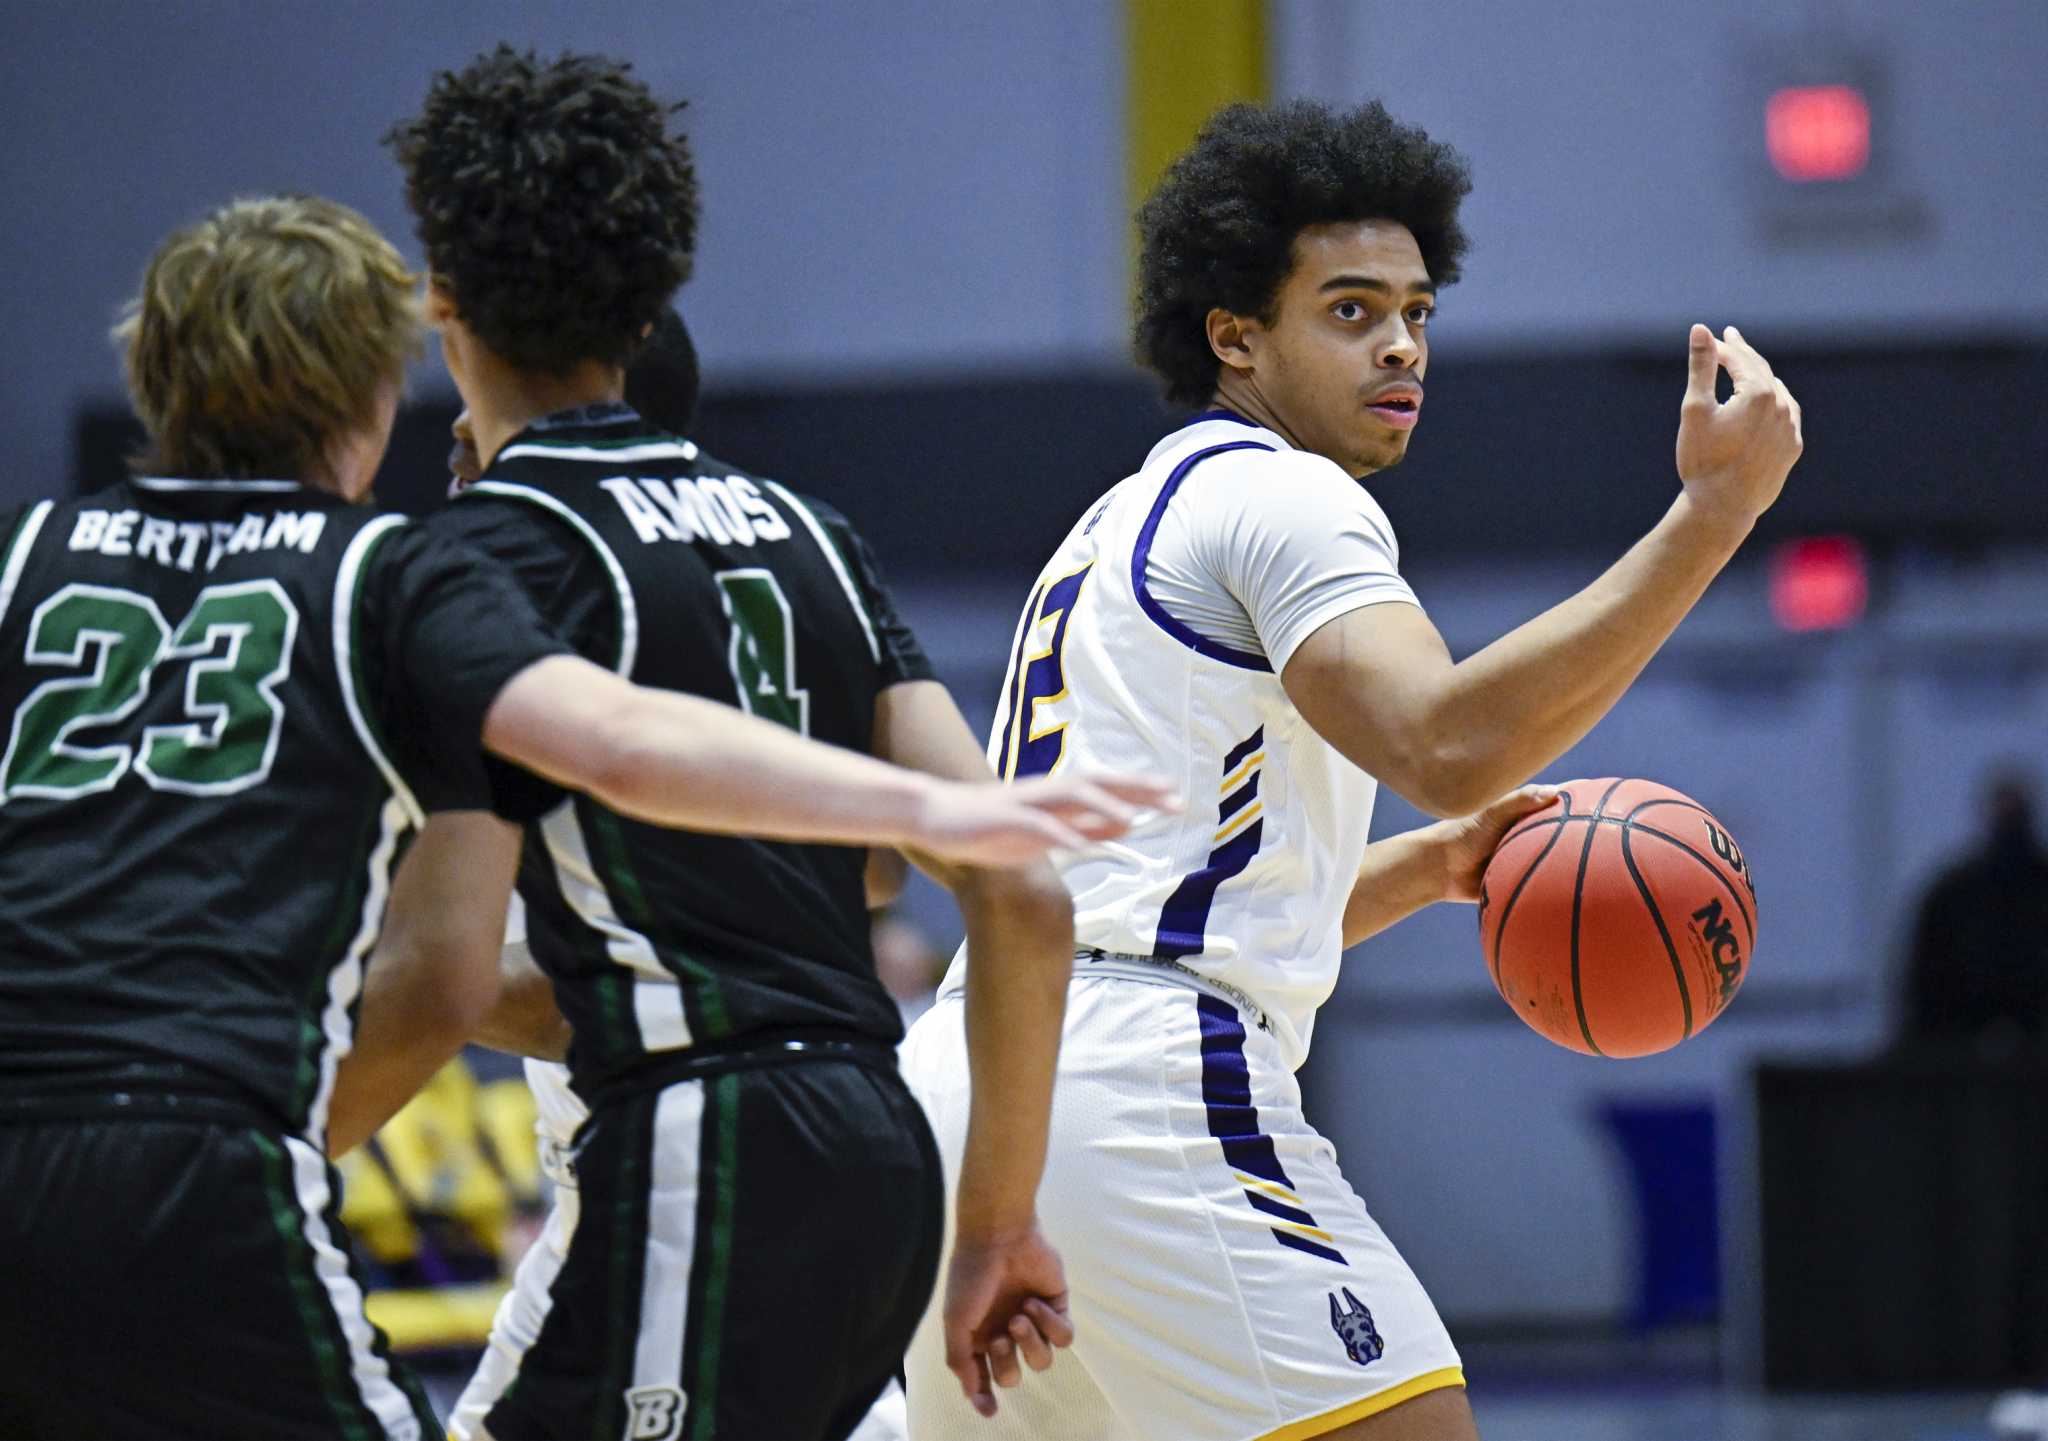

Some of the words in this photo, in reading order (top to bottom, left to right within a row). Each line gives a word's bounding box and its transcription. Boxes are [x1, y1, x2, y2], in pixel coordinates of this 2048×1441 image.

[598, 475, 791, 547] AMOS
[0, 579, 300, 800] 23
[624, 1385, 688, 1441] B
